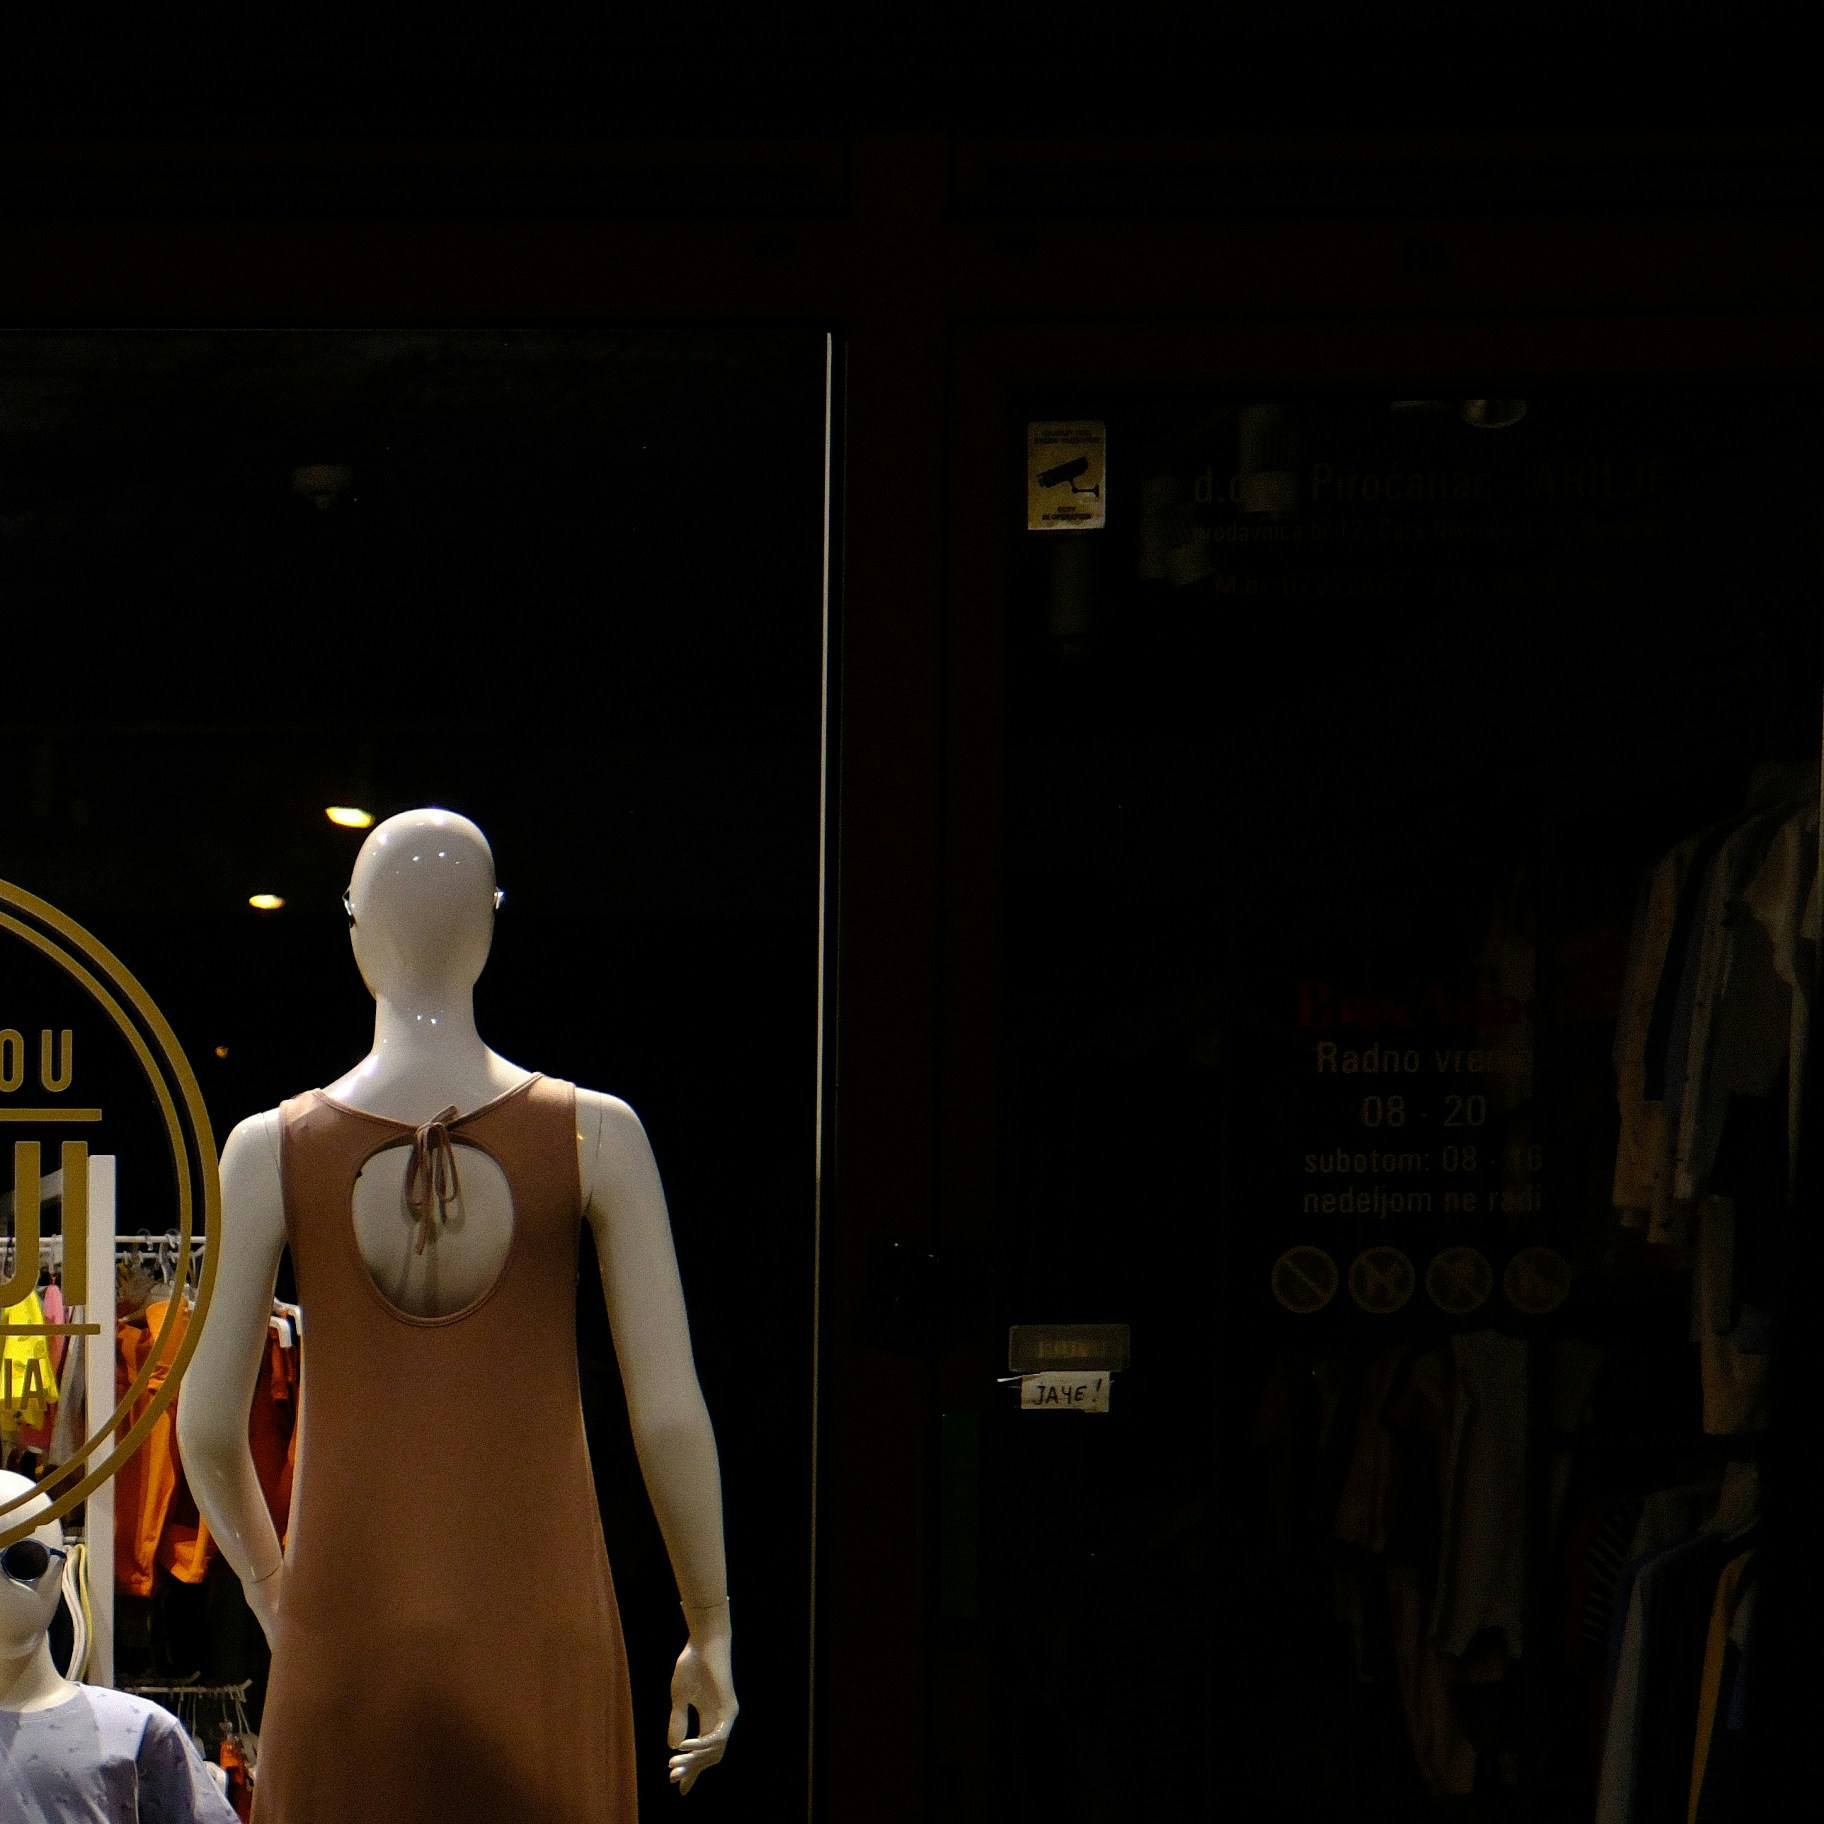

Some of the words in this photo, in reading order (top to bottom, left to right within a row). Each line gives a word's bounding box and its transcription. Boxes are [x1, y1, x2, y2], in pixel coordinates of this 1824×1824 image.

[40, 1029, 75, 1092] U
[1315, 1041, 1421, 1074] Radno
[1362, 1095, 1407, 1128] 08
[1443, 1094, 1487, 1128] 20
[1441, 1145, 1478, 1173] 08
[1303, 1185, 1432, 1220] nedeljom
[1444, 1192, 1477, 1214] ne
